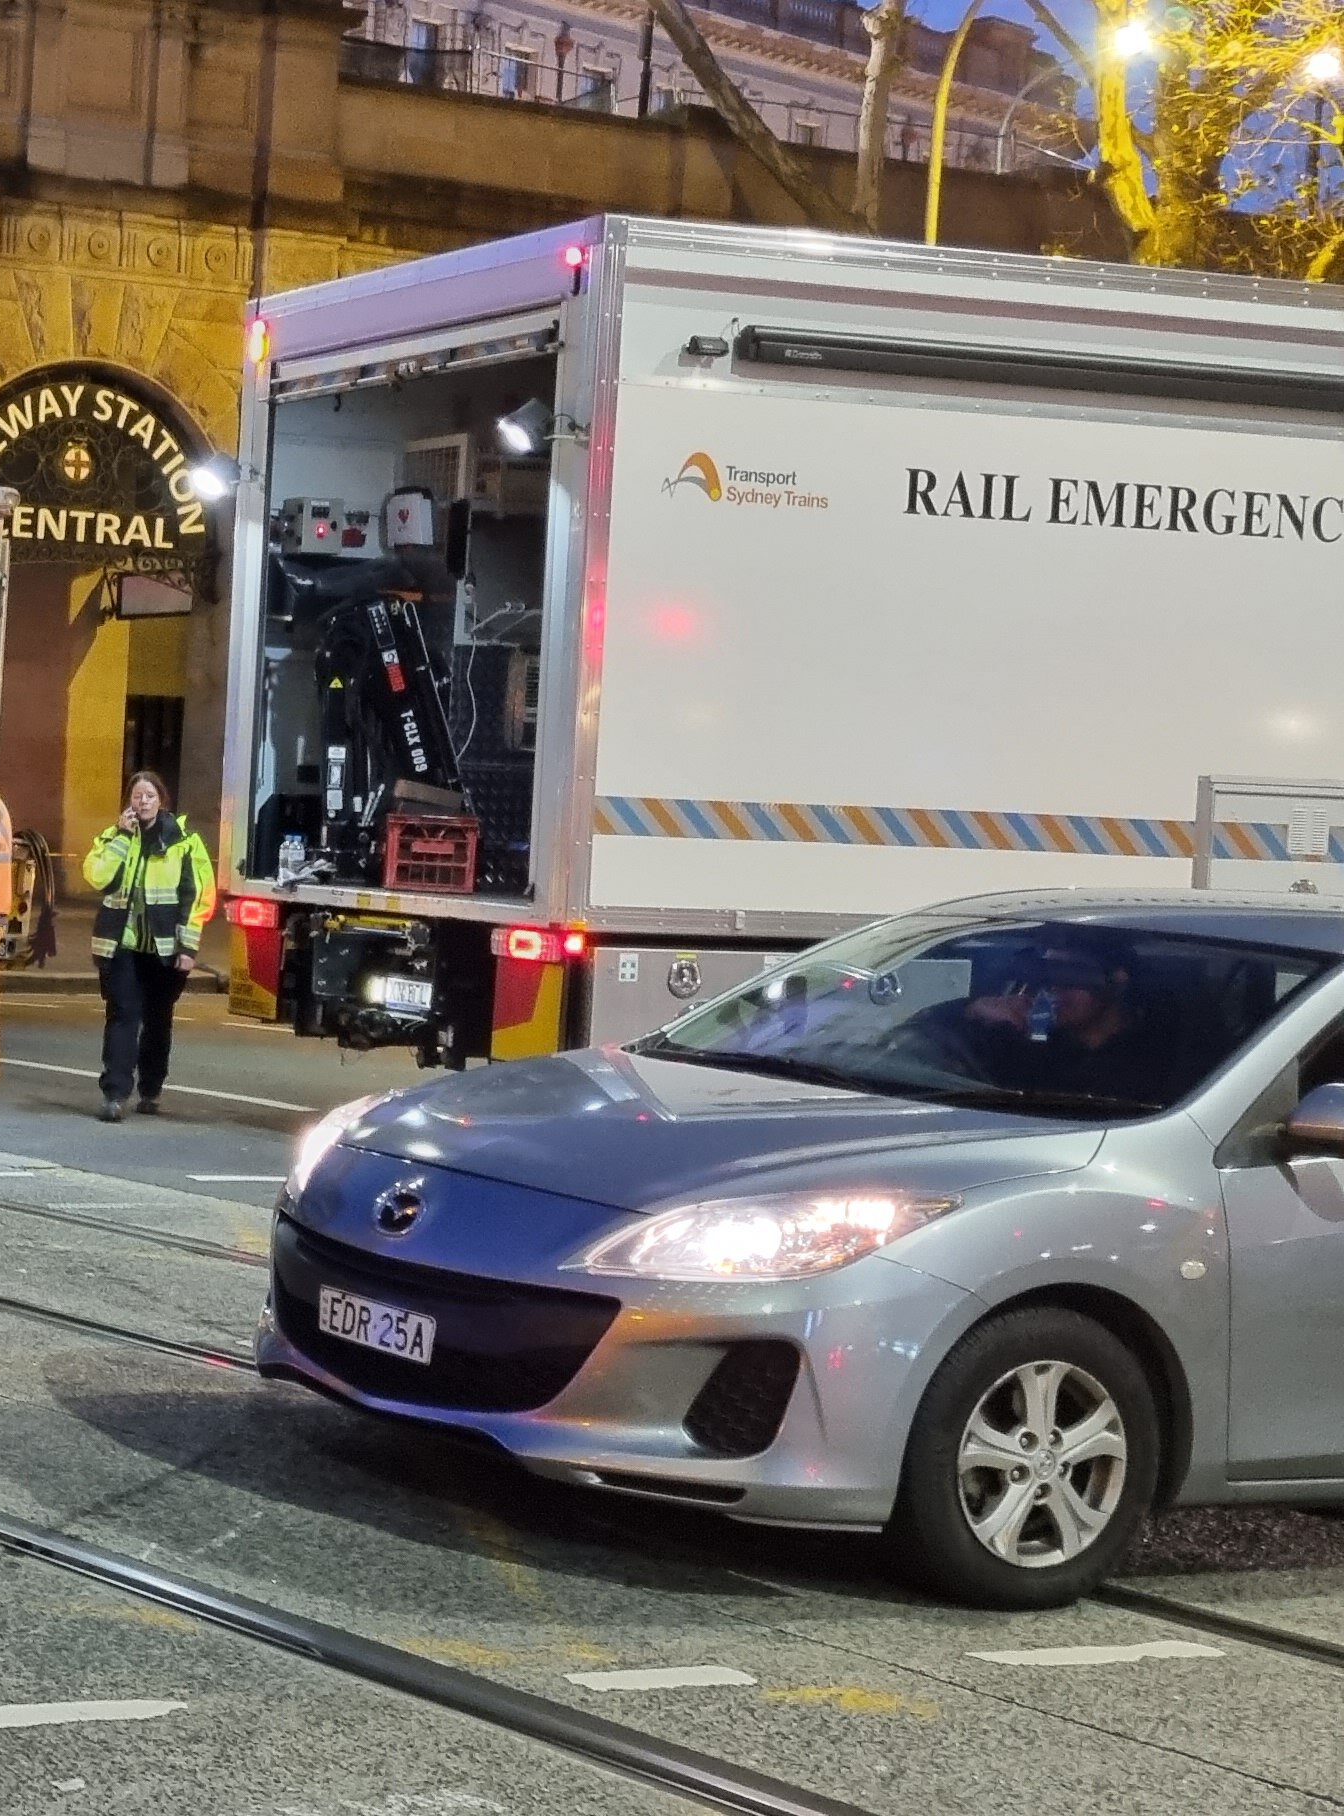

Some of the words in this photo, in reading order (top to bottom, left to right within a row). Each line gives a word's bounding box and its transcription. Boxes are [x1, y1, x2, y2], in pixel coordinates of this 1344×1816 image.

[92, 388, 206, 536] STATION
[726, 465, 797, 487] Transport
[726, 486, 781, 509] Sydney
[784, 490, 829, 509] Trains
[903, 467, 1033, 523] RAIL
[1046, 476, 1344, 544] EMERGENC
[2, 506, 174, 549] ENTRAL
